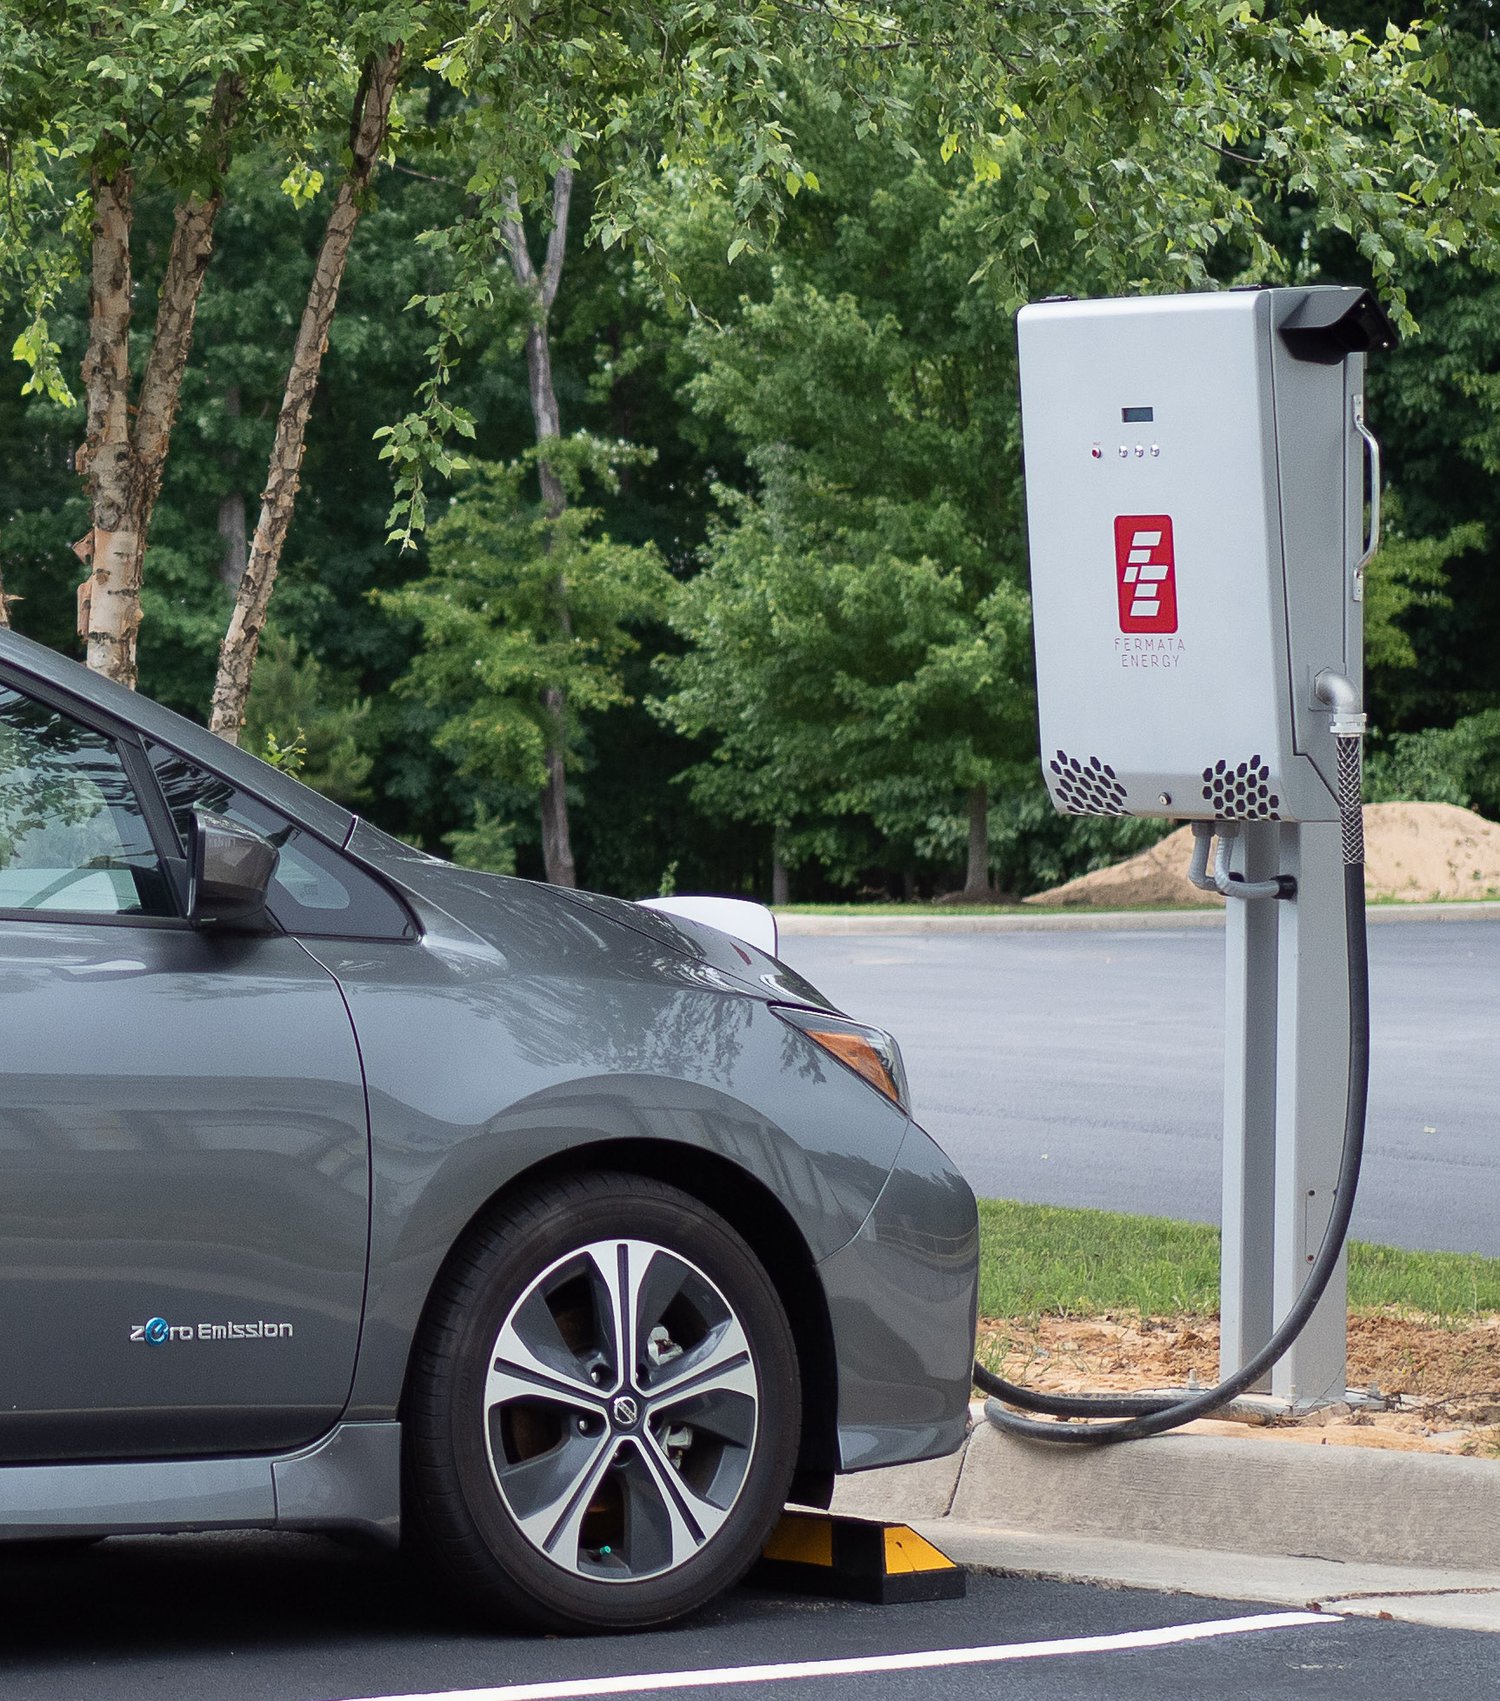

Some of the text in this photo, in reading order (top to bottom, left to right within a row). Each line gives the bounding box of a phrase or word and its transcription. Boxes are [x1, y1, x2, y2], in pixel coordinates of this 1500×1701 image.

[1113, 637, 1186, 652] FERMATA
[1121, 654, 1180, 668] ENERGY
[129, 1316, 294, 1346] zero Emission
